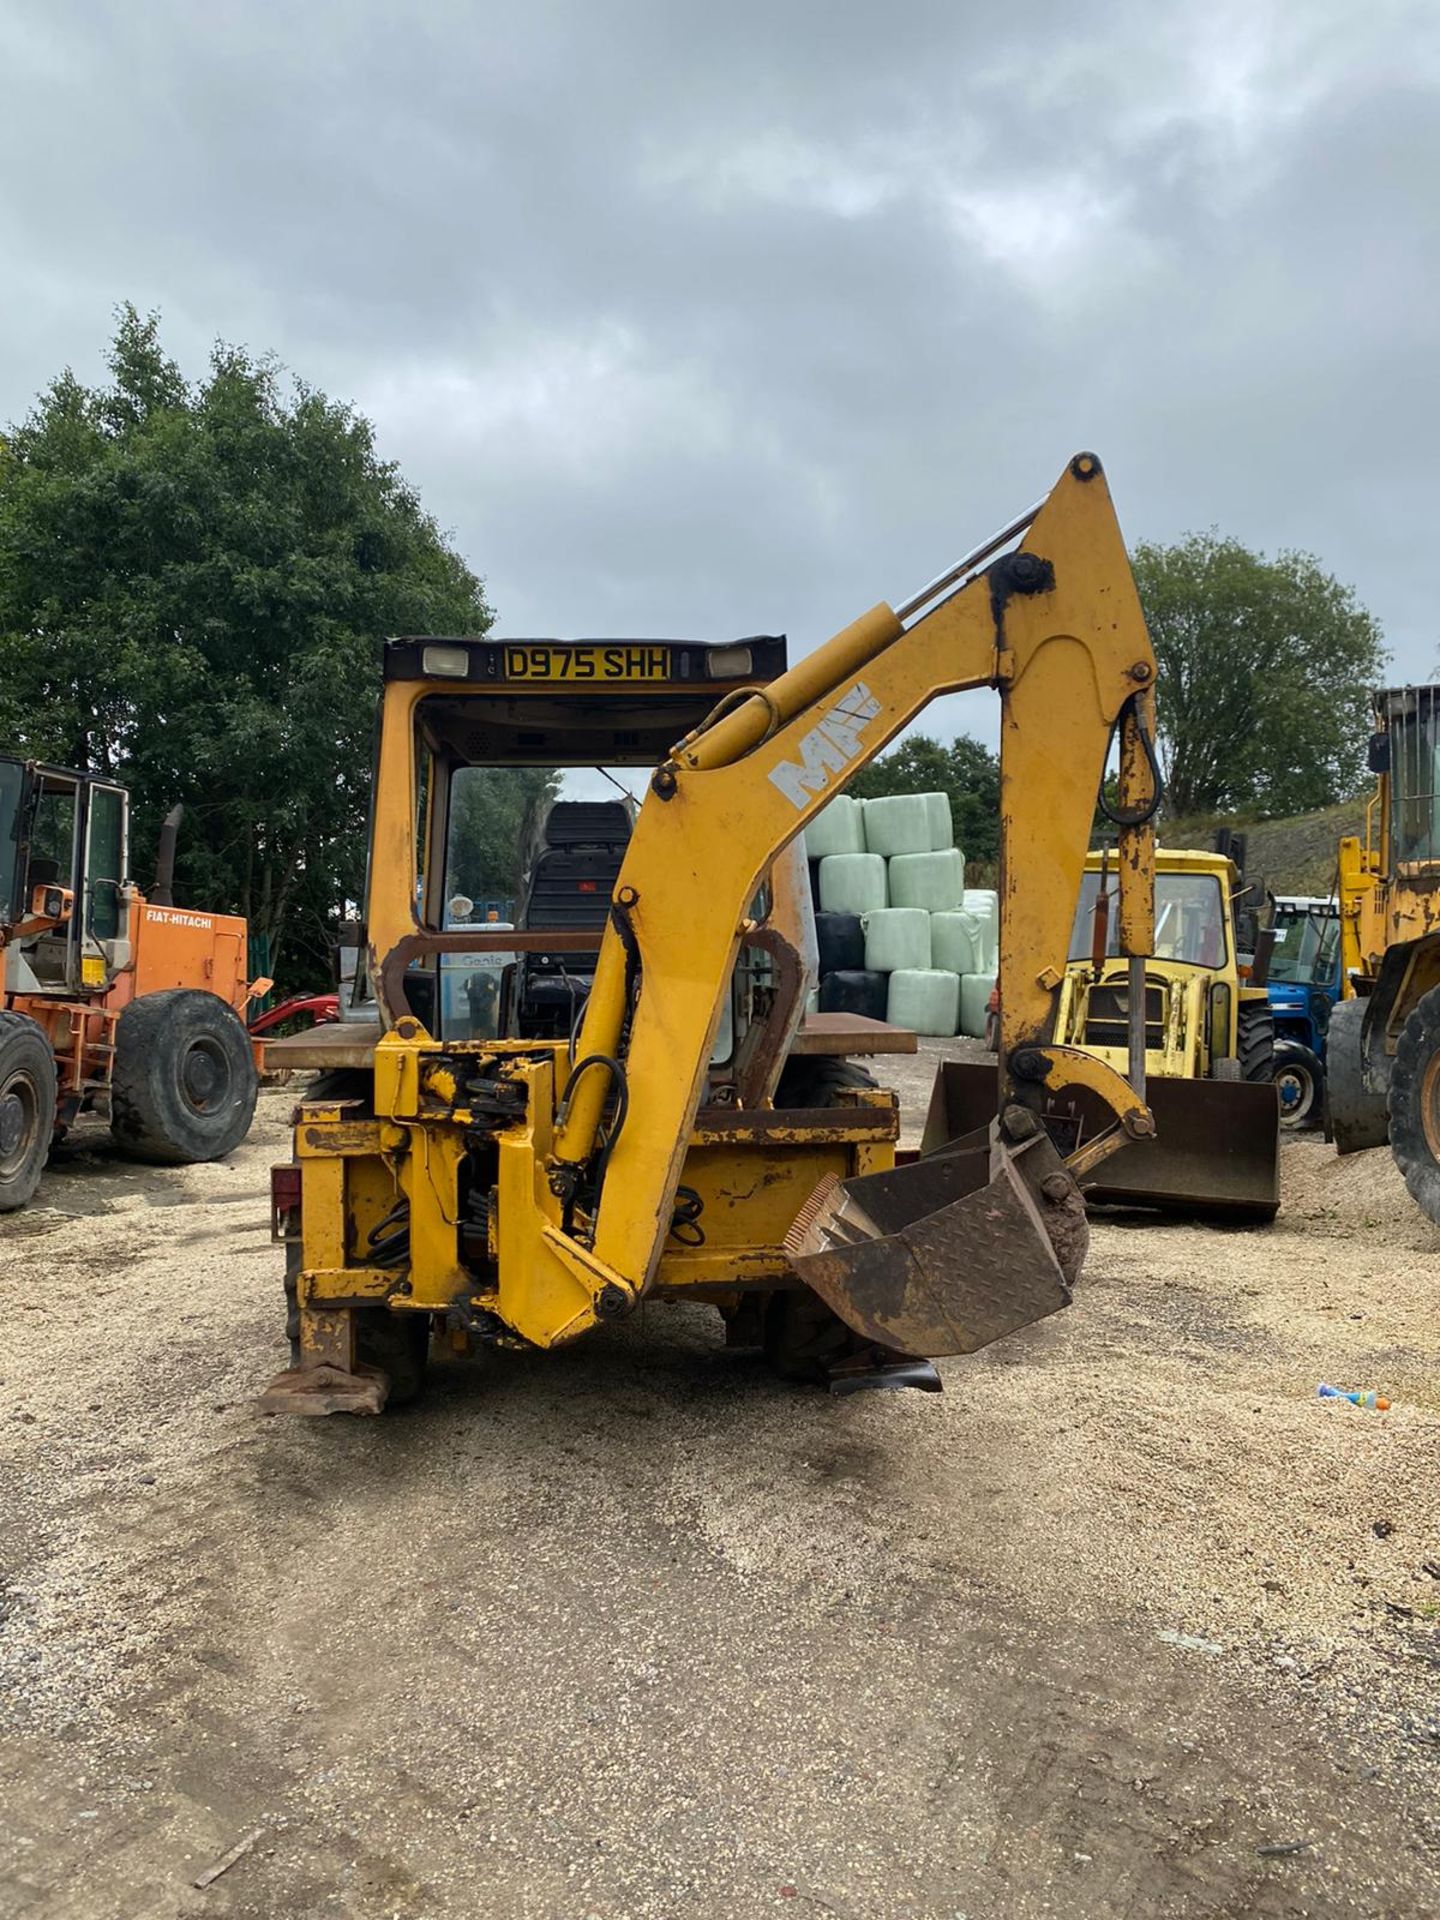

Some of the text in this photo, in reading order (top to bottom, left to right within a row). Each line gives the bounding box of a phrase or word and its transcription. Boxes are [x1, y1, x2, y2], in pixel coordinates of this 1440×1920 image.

[508, 649, 668, 677] D975 SHH
[146, 910, 212, 929] FIAT-HITACHI
